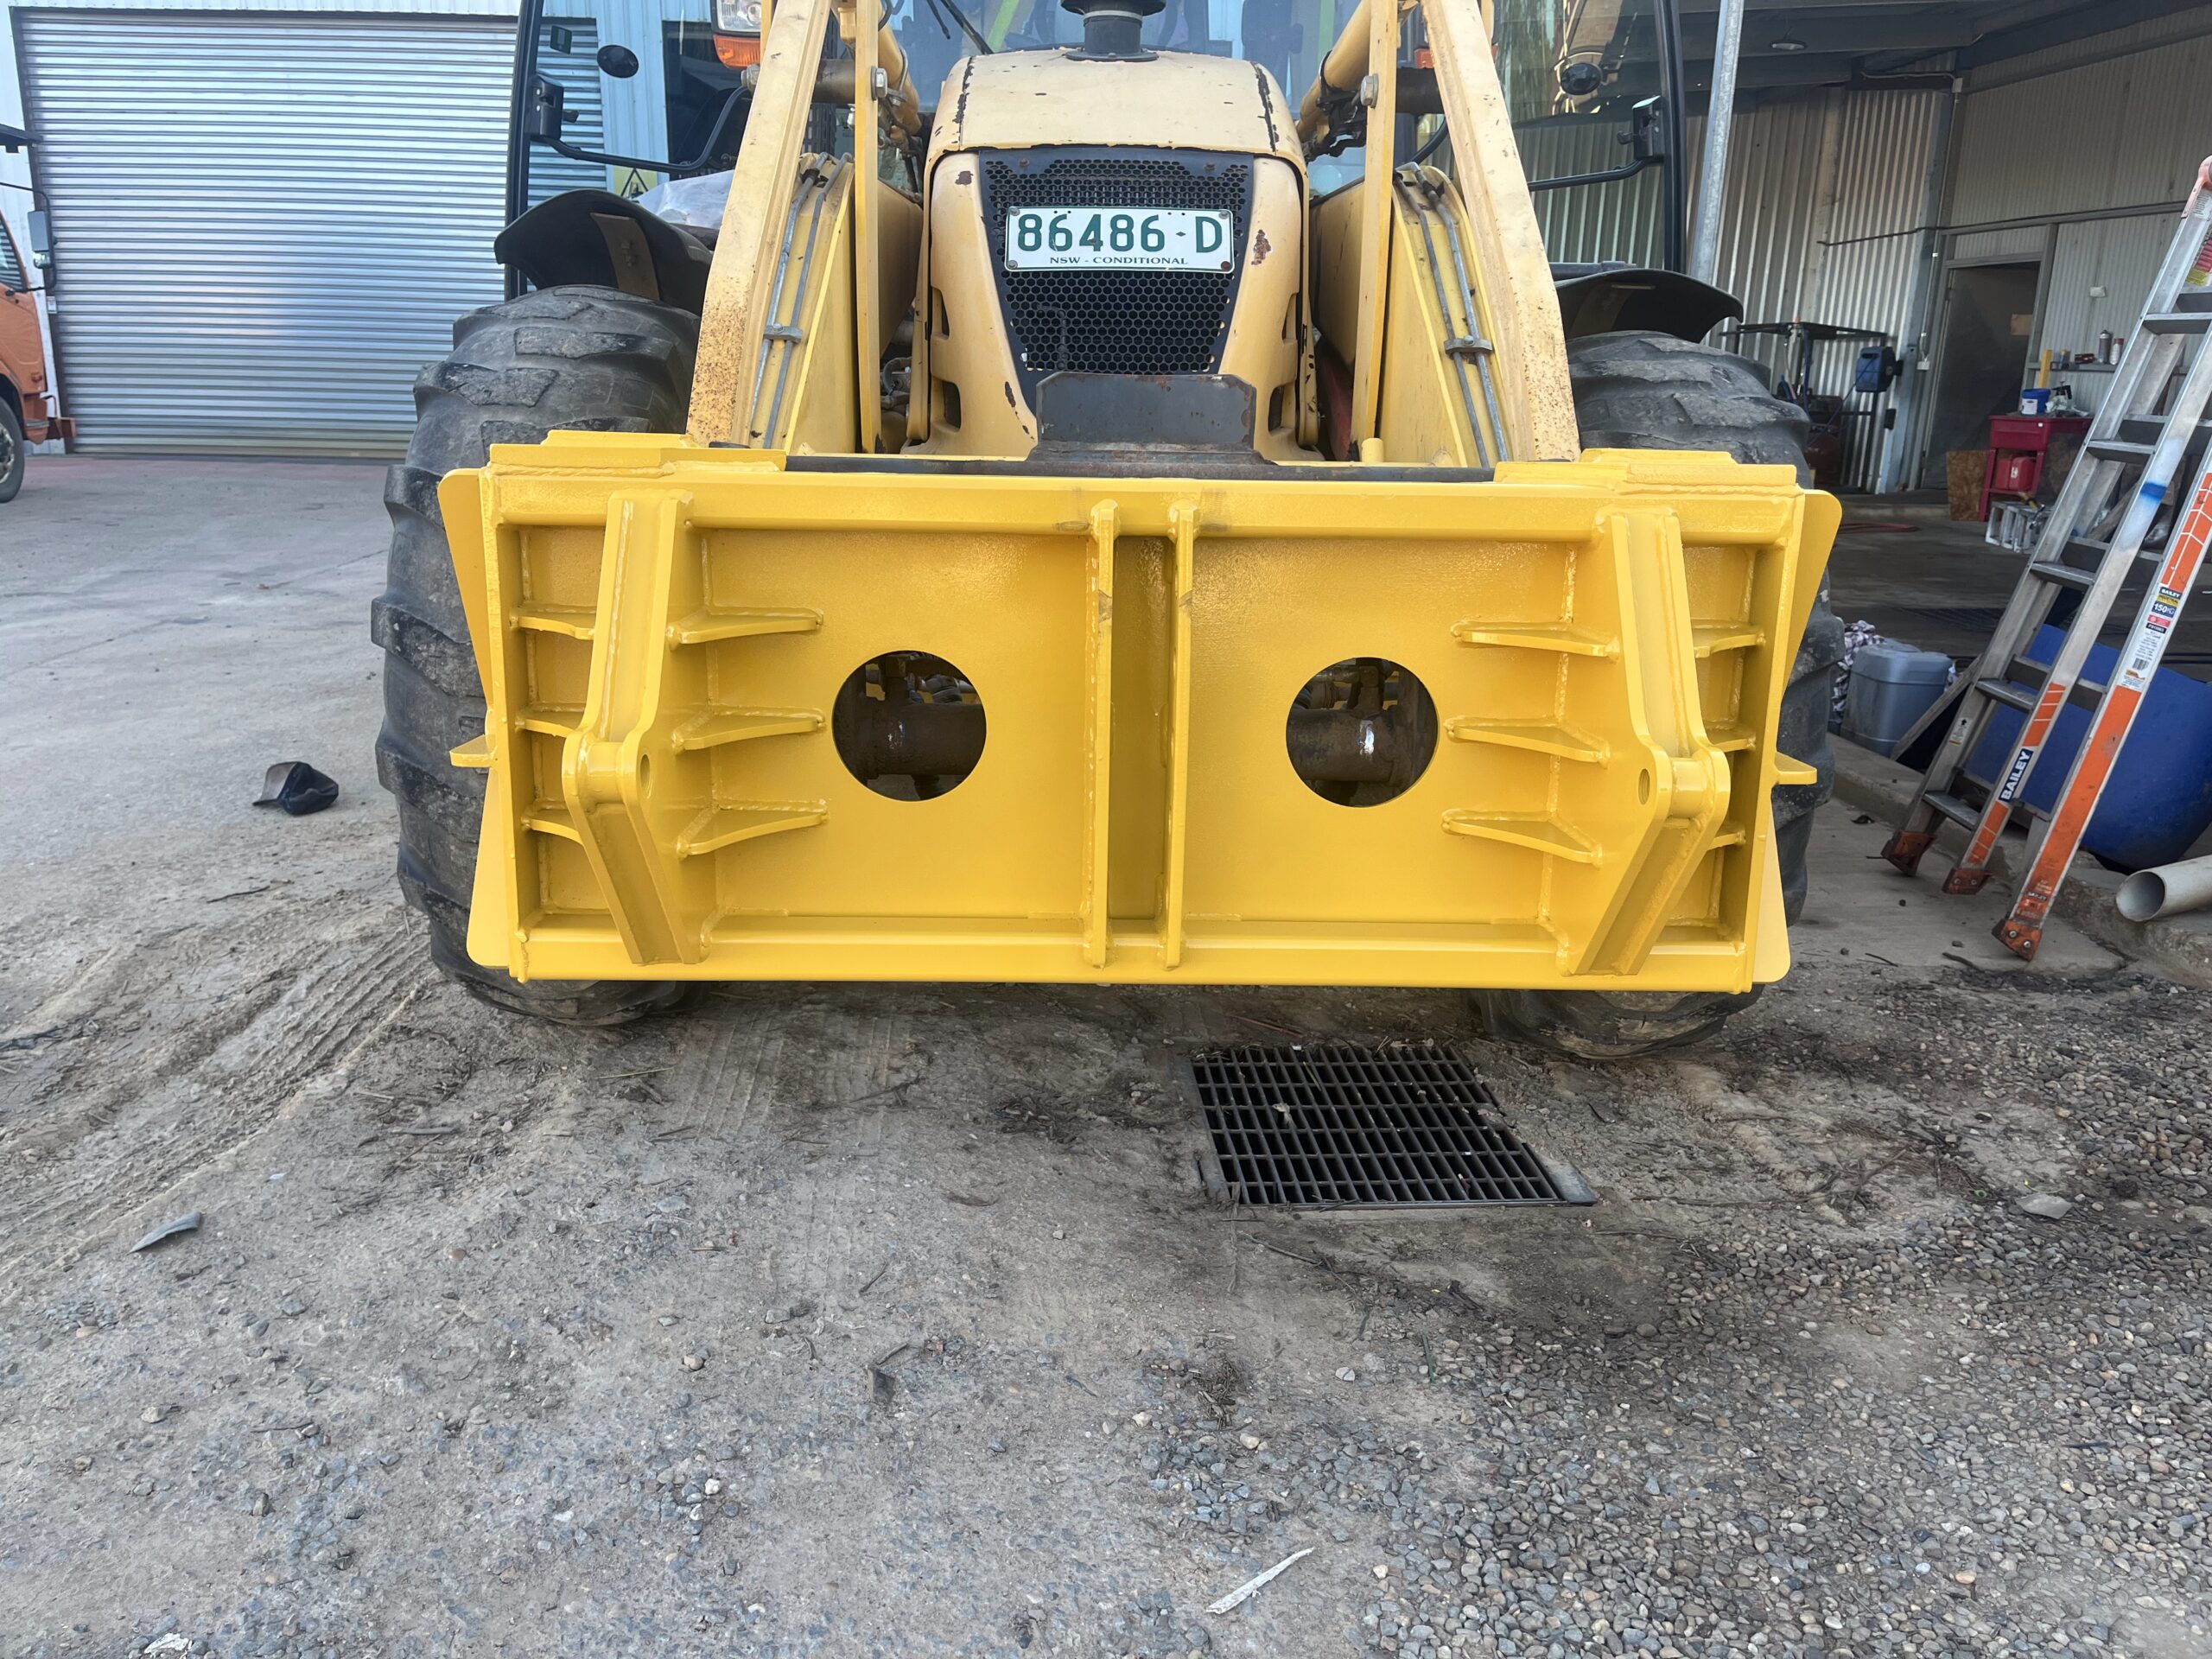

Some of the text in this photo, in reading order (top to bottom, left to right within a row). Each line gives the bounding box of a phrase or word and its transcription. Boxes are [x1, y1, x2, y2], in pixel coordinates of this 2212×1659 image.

[1093, 256, 1189, 265] CONDITIONAL
[2161, 588, 2181, 598] BAILEY
[2000, 750, 2031, 800] BAILEY
